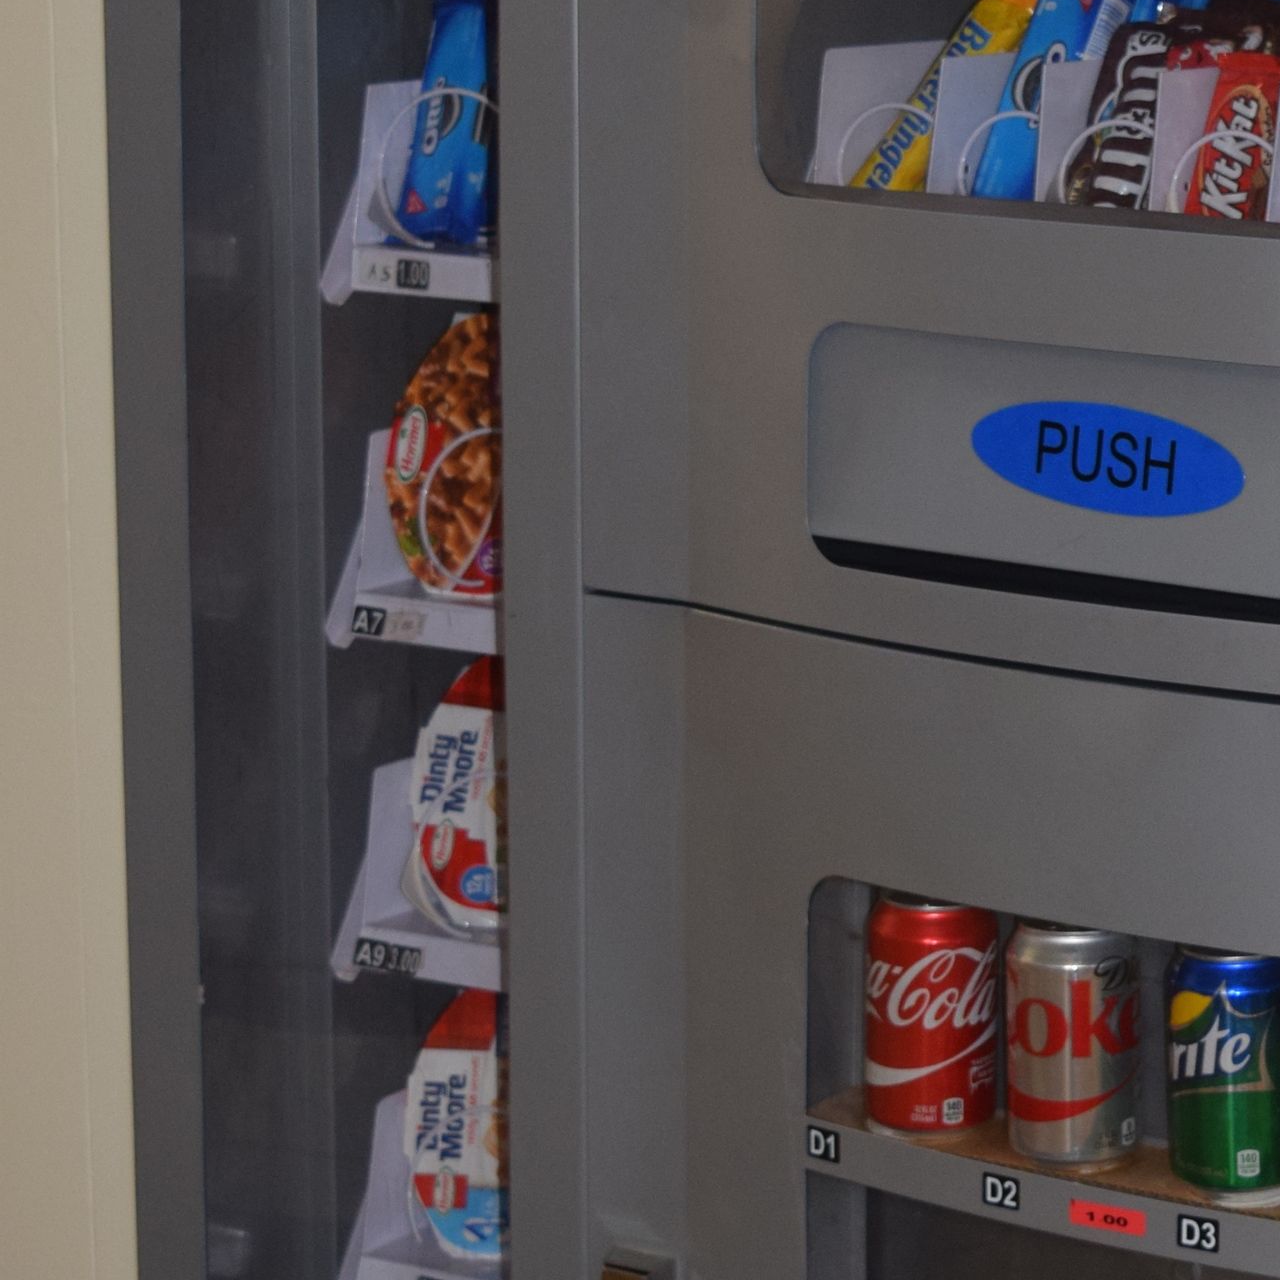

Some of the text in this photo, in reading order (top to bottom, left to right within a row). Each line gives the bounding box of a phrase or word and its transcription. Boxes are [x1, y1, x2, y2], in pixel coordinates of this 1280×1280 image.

[1035, 418, 1177, 496] PUSH
[353, 607, 384, 634] A7
[355, 940, 387, 969] A9
[866, 939, 997, 1031] a-Cola
[1171, 1016, 1251, 1079] rite
[808, 1128, 838, 1160] D1
[984, 1175, 1018, 1207] D2
[1181, 1219, 1217, 1249] D3
